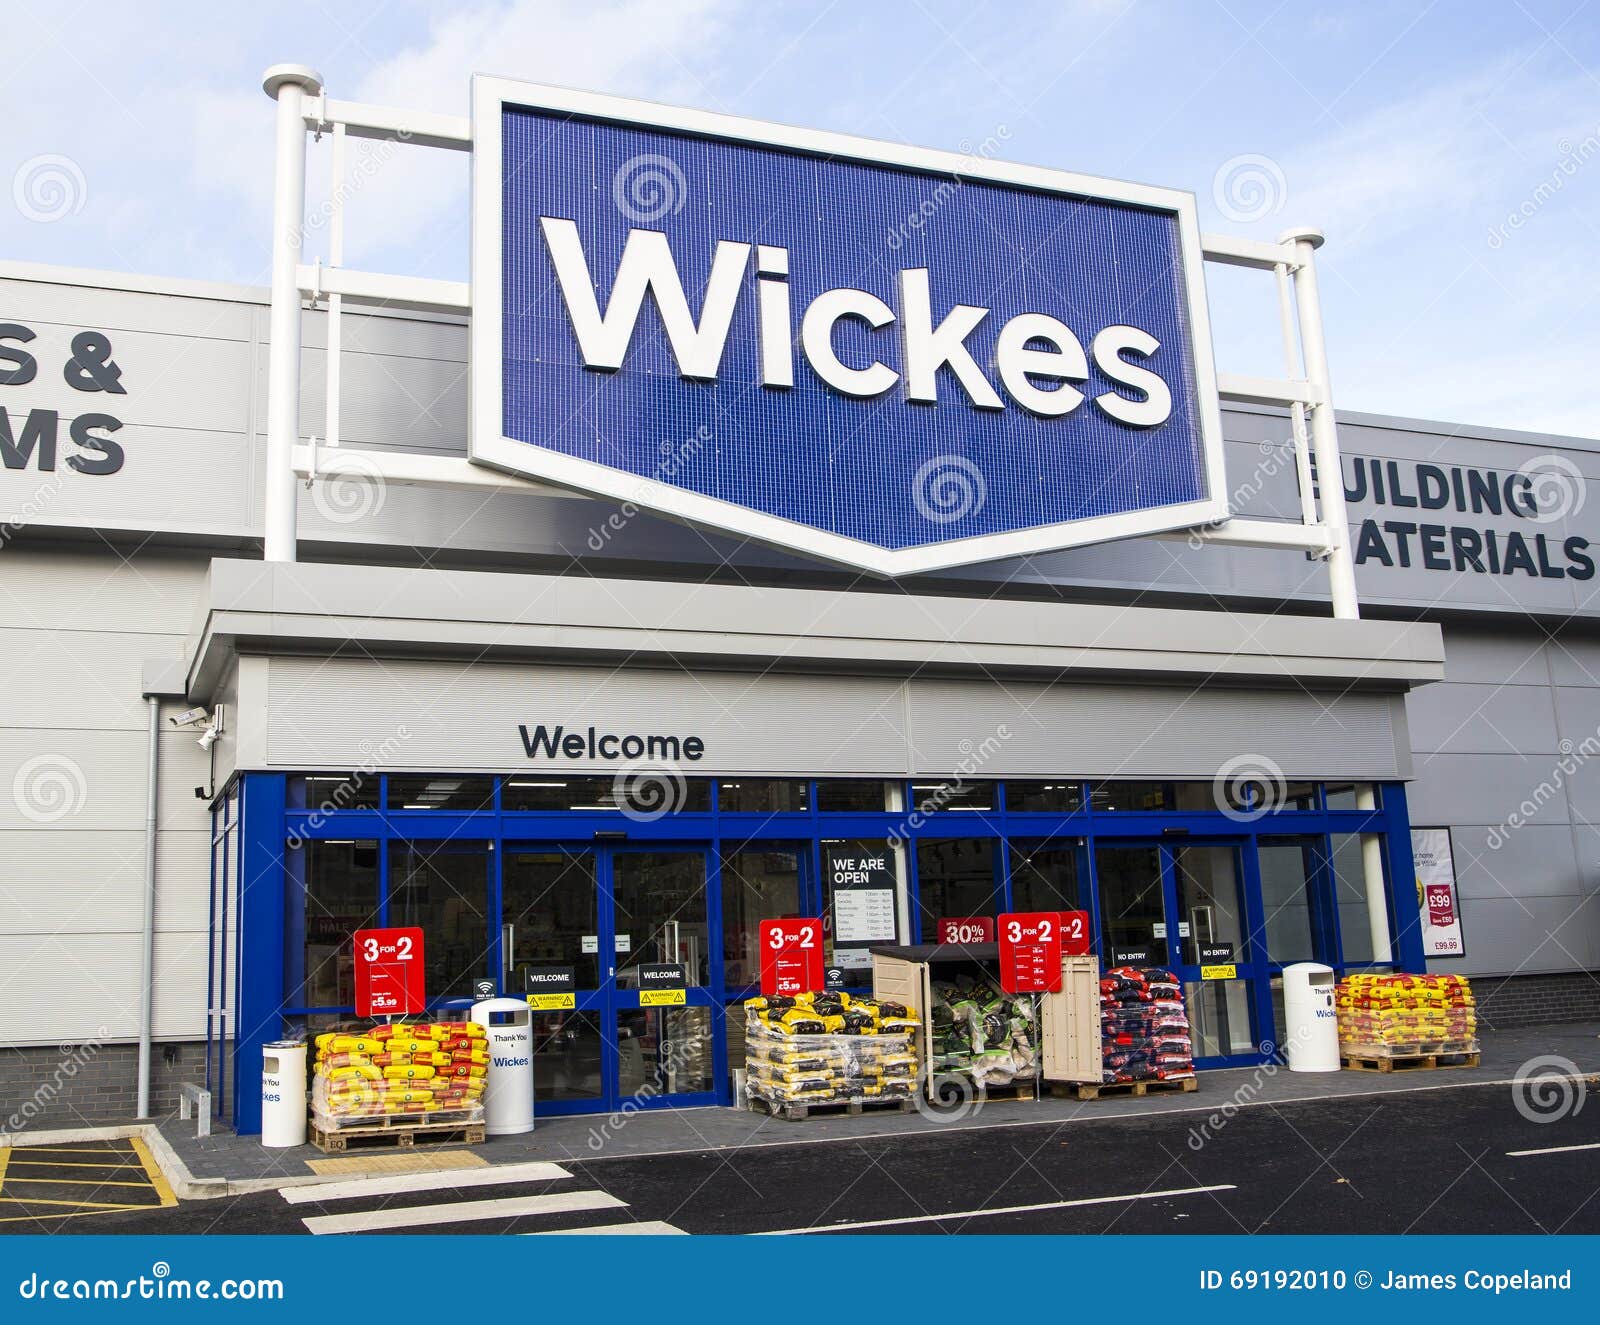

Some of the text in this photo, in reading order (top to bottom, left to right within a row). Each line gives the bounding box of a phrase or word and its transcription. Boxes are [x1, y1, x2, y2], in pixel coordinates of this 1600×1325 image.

[540, 216, 1172, 427] Wickes
[63, 331, 127, 394] &
[1302, 516, 1595, 580] ATERIALS
[518, 725, 705, 761] Welcome
[833, 859, 885, 871] WE ARE
[834, 872, 869, 883] OPEN
[1430, 895, 1450, 907] £99
[946, 924, 985, 943] 30%
[1007, 921, 1022, 943] 3
[1038, 920, 1052, 942] 2
[1071, 918, 1082, 938] 2
[770, 927, 784, 949] 3
[800, 926, 814, 948] 2
[364, 936, 413, 962] 3 FOR 2
[1128, 952, 1145, 960] ENTRY
[1212, 948, 1229, 956] ENTRY
[530, 974, 569, 982] WELCOME
[643, 971, 680, 979] WELCOME
[494, 1034, 515, 1042] Thank
[494, 1057, 529, 1067] Wickes
